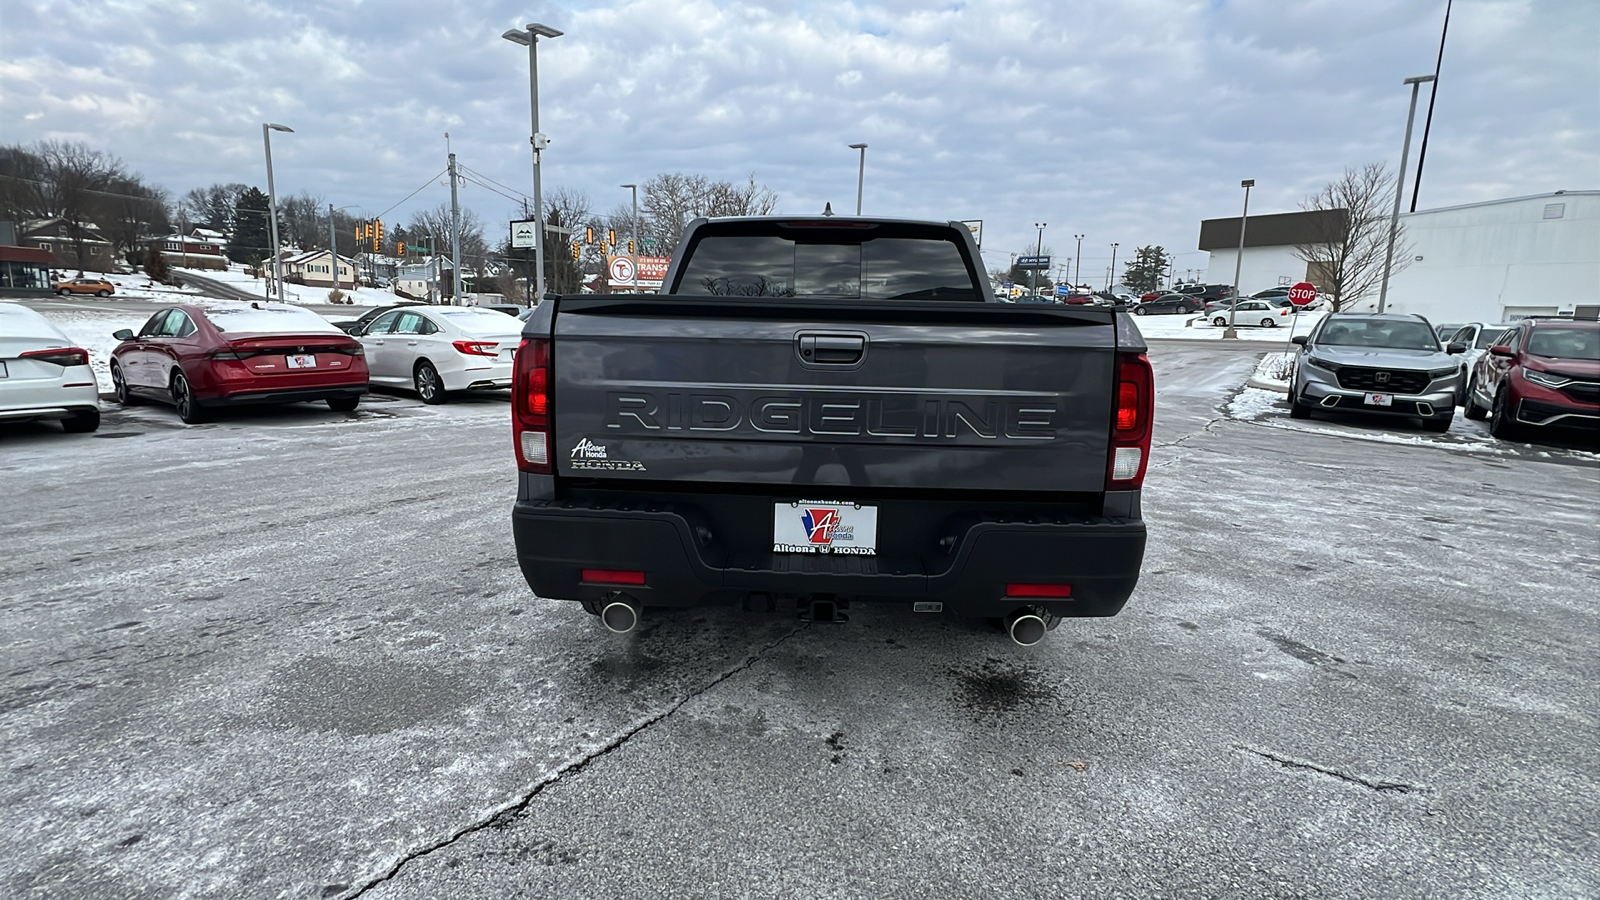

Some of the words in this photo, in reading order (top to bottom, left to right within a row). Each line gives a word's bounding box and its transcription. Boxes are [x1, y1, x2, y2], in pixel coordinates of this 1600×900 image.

[1290, 288, 1316, 299] STOP
[606, 391, 1058, 440] RIDGELINE
[570, 459, 647, 471] HONDA
[827, 532, 853, 540] Honda
[773, 544, 816, 553] Altoona
[834, 547, 876, 555] HONDA
